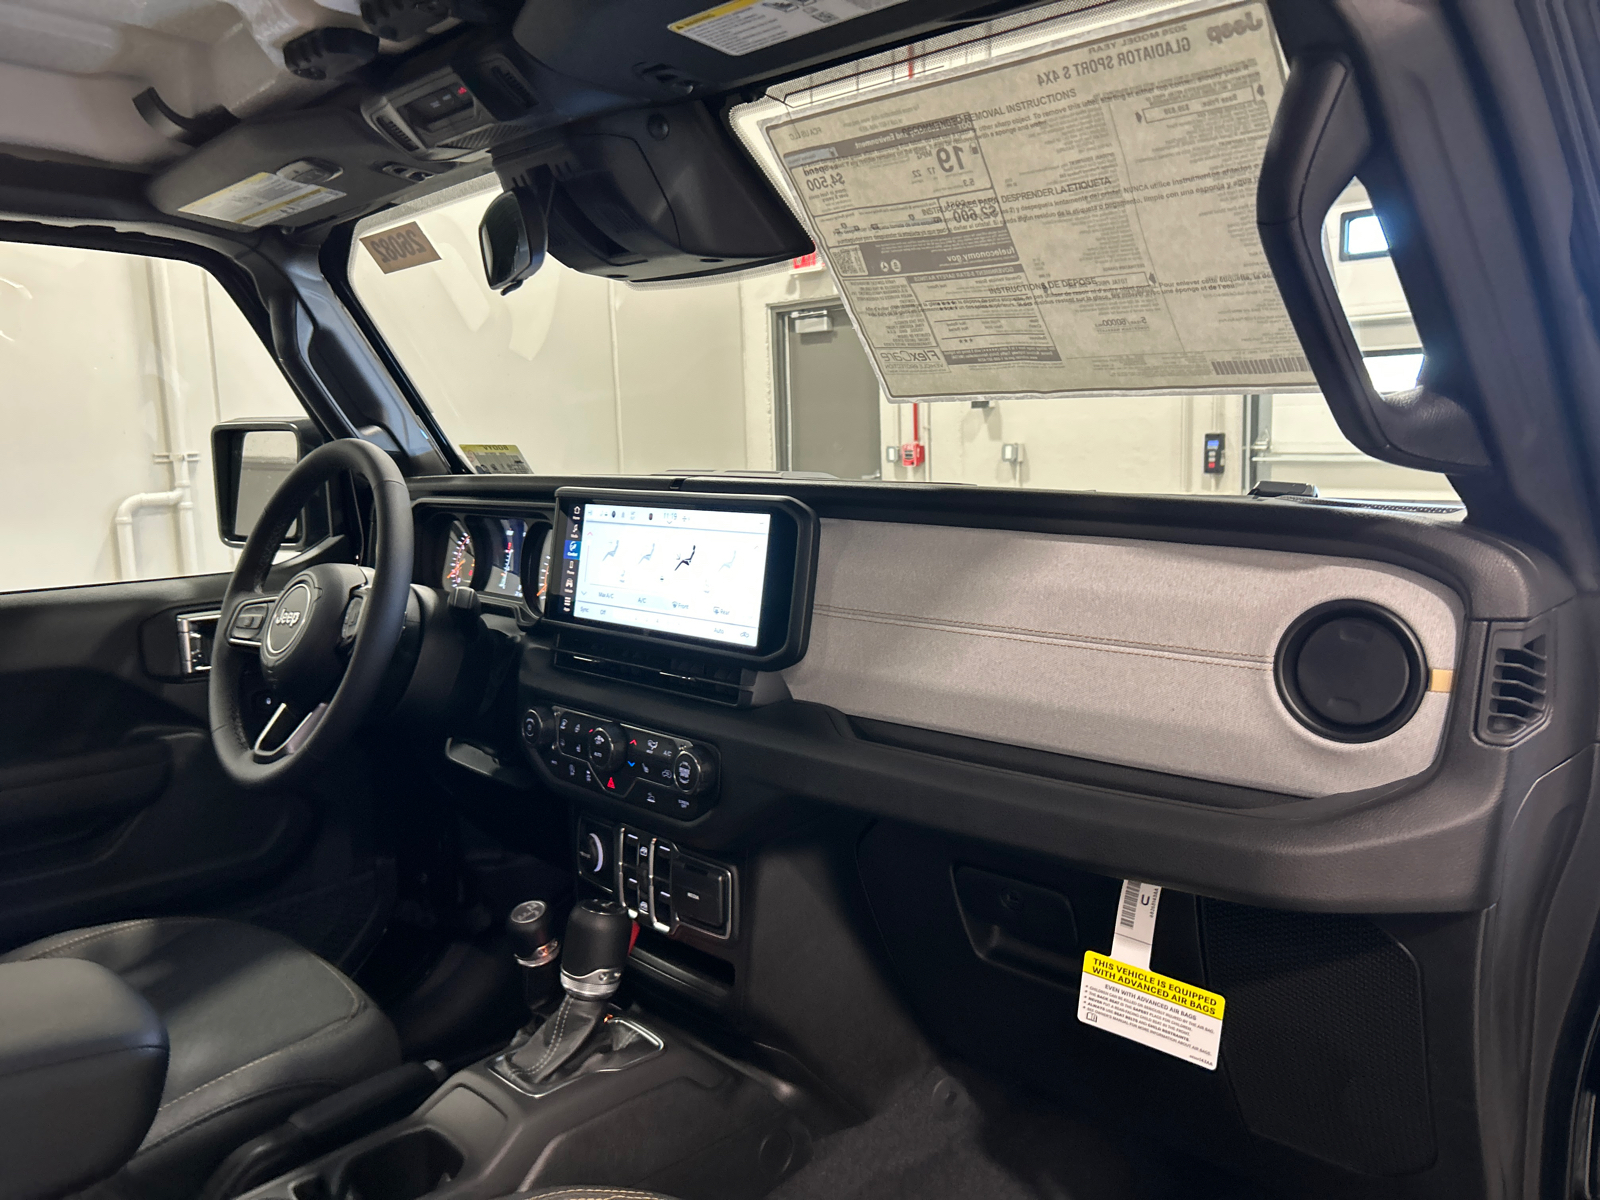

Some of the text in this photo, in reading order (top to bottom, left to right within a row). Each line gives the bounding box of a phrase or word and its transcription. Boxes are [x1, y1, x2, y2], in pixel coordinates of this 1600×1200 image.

[963, 88, 1077, 122] REMOVAL INSTRUCTIONS
[1032, 111, 1041, 119] To
[1041, 105, 1067, 117] remove
[1066, 101, 1080, 111] this
[994, 126, 1017, 137] sponge
[1016, 123, 1029, 131] and
[1000, 187, 1055, 203] DESPRENDER
[1054, 184, 1067, 195] LA
[1065, 176, 1112, 192] ETIQUETA
[1122, 183, 1149, 194] NUNCA
[1149, 179, 1171, 189] utilice
[1143, 193, 1164, 202] limpie
[1179, 188, 1194, 196] una
[275, 608, 301, 627] Jeep
[1141, 894, 1151, 906] U
[1092, 957, 1217, 1006] THIS VEHICLE IS EQUIPPED
[1092, 965, 1215, 1015] WITH ADVANCED AIR BAGS
[1104, 983, 1196, 1020] EVEN WITH ADVANCED AIR BAGS
